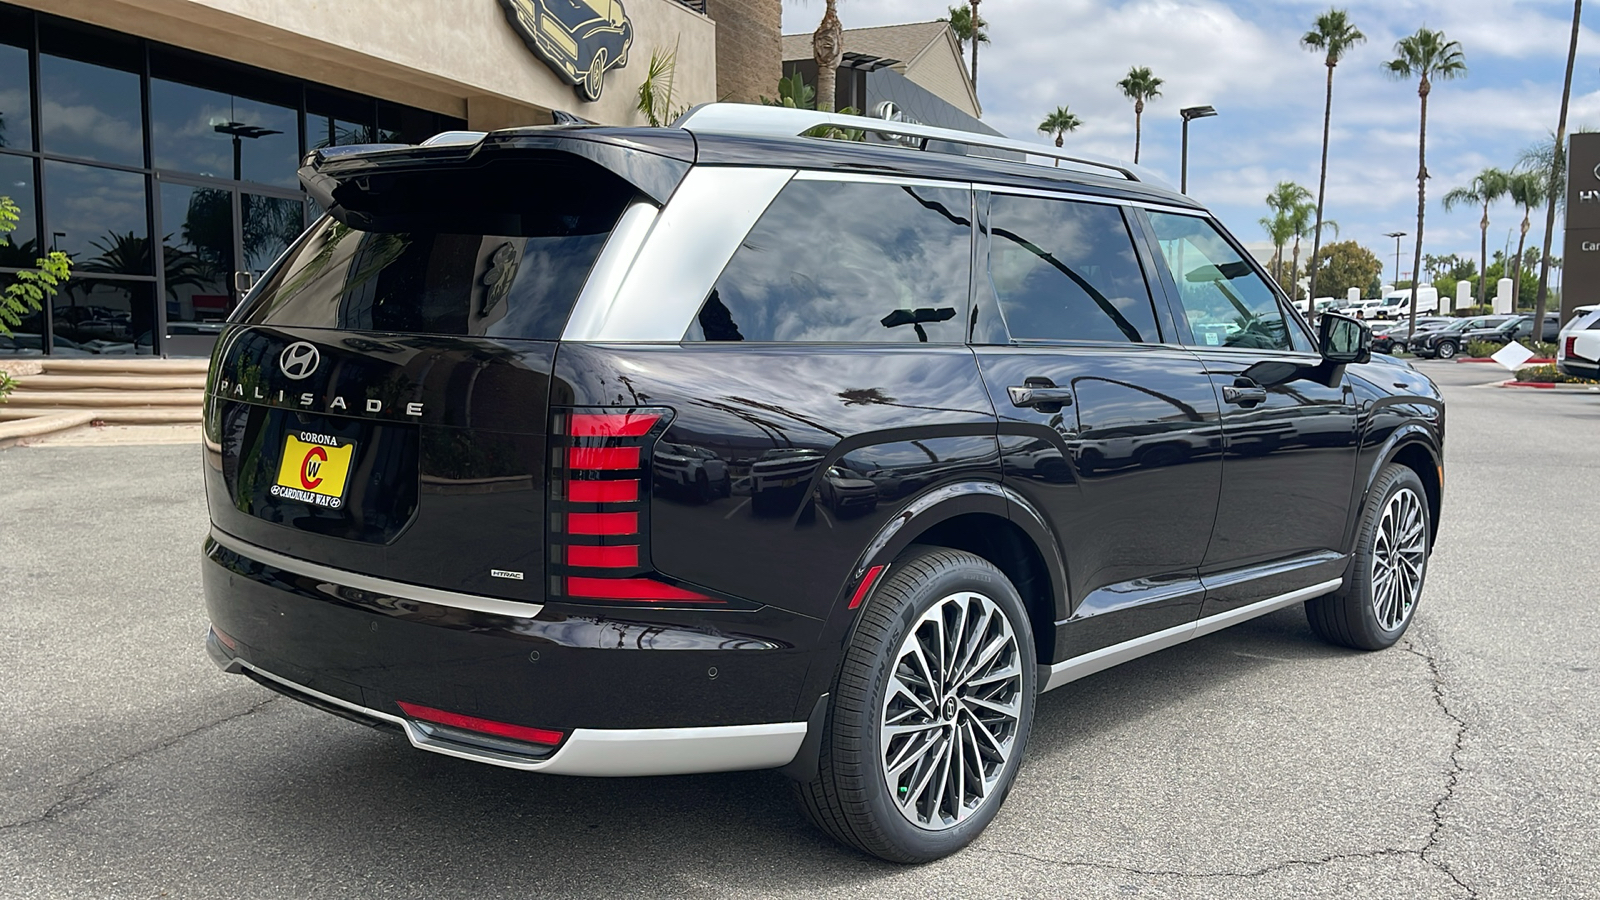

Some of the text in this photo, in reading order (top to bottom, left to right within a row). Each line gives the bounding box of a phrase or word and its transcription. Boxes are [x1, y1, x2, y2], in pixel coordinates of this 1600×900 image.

[220, 380, 424, 417] PALISADE
[300, 431, 337, 446] CORONA
[280, 487, 331, 506] CARDINALE WAY
[492, 570, 522, 579] HTRAC
